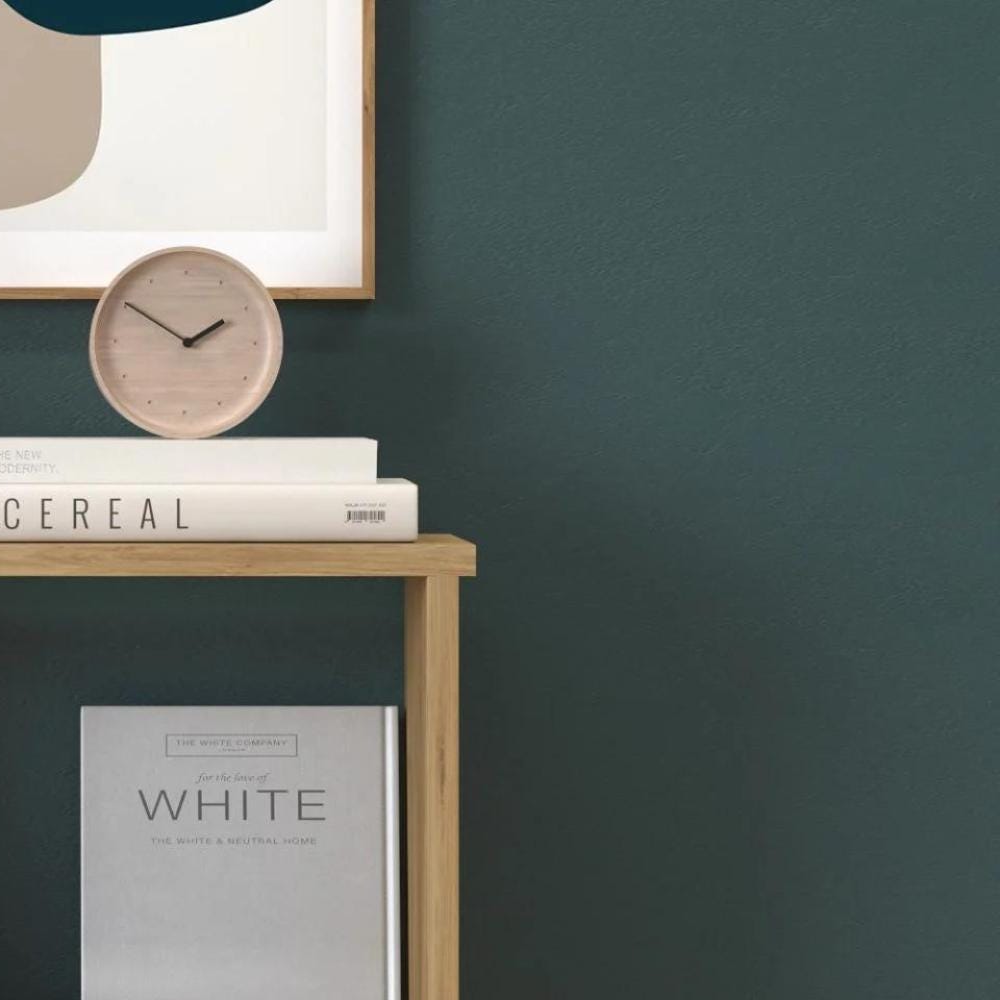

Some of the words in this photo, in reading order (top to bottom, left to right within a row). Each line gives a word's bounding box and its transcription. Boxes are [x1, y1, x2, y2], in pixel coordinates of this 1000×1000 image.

[15, 450, 42, 460] NEW
[3, 497, 190, 530] CEREAL
[176, 738, 196, 747] THE
[199, 738, 232, 747] WHITE
[235, 738, 288, 747] COMPANY
[194, 772, 213, 785] for
[215, 772, 231, 783] the
[256, 771, 272, 785] of
[138, 789, 327, 821] WHITE
[151, 836, 173, 846] THE
[176, 836, 212, 846] WHITE
[215, 836, 224, 846] &
[227, 836, 279, 846] NEUTRAL
[282, 836, 318, 846] HOME
